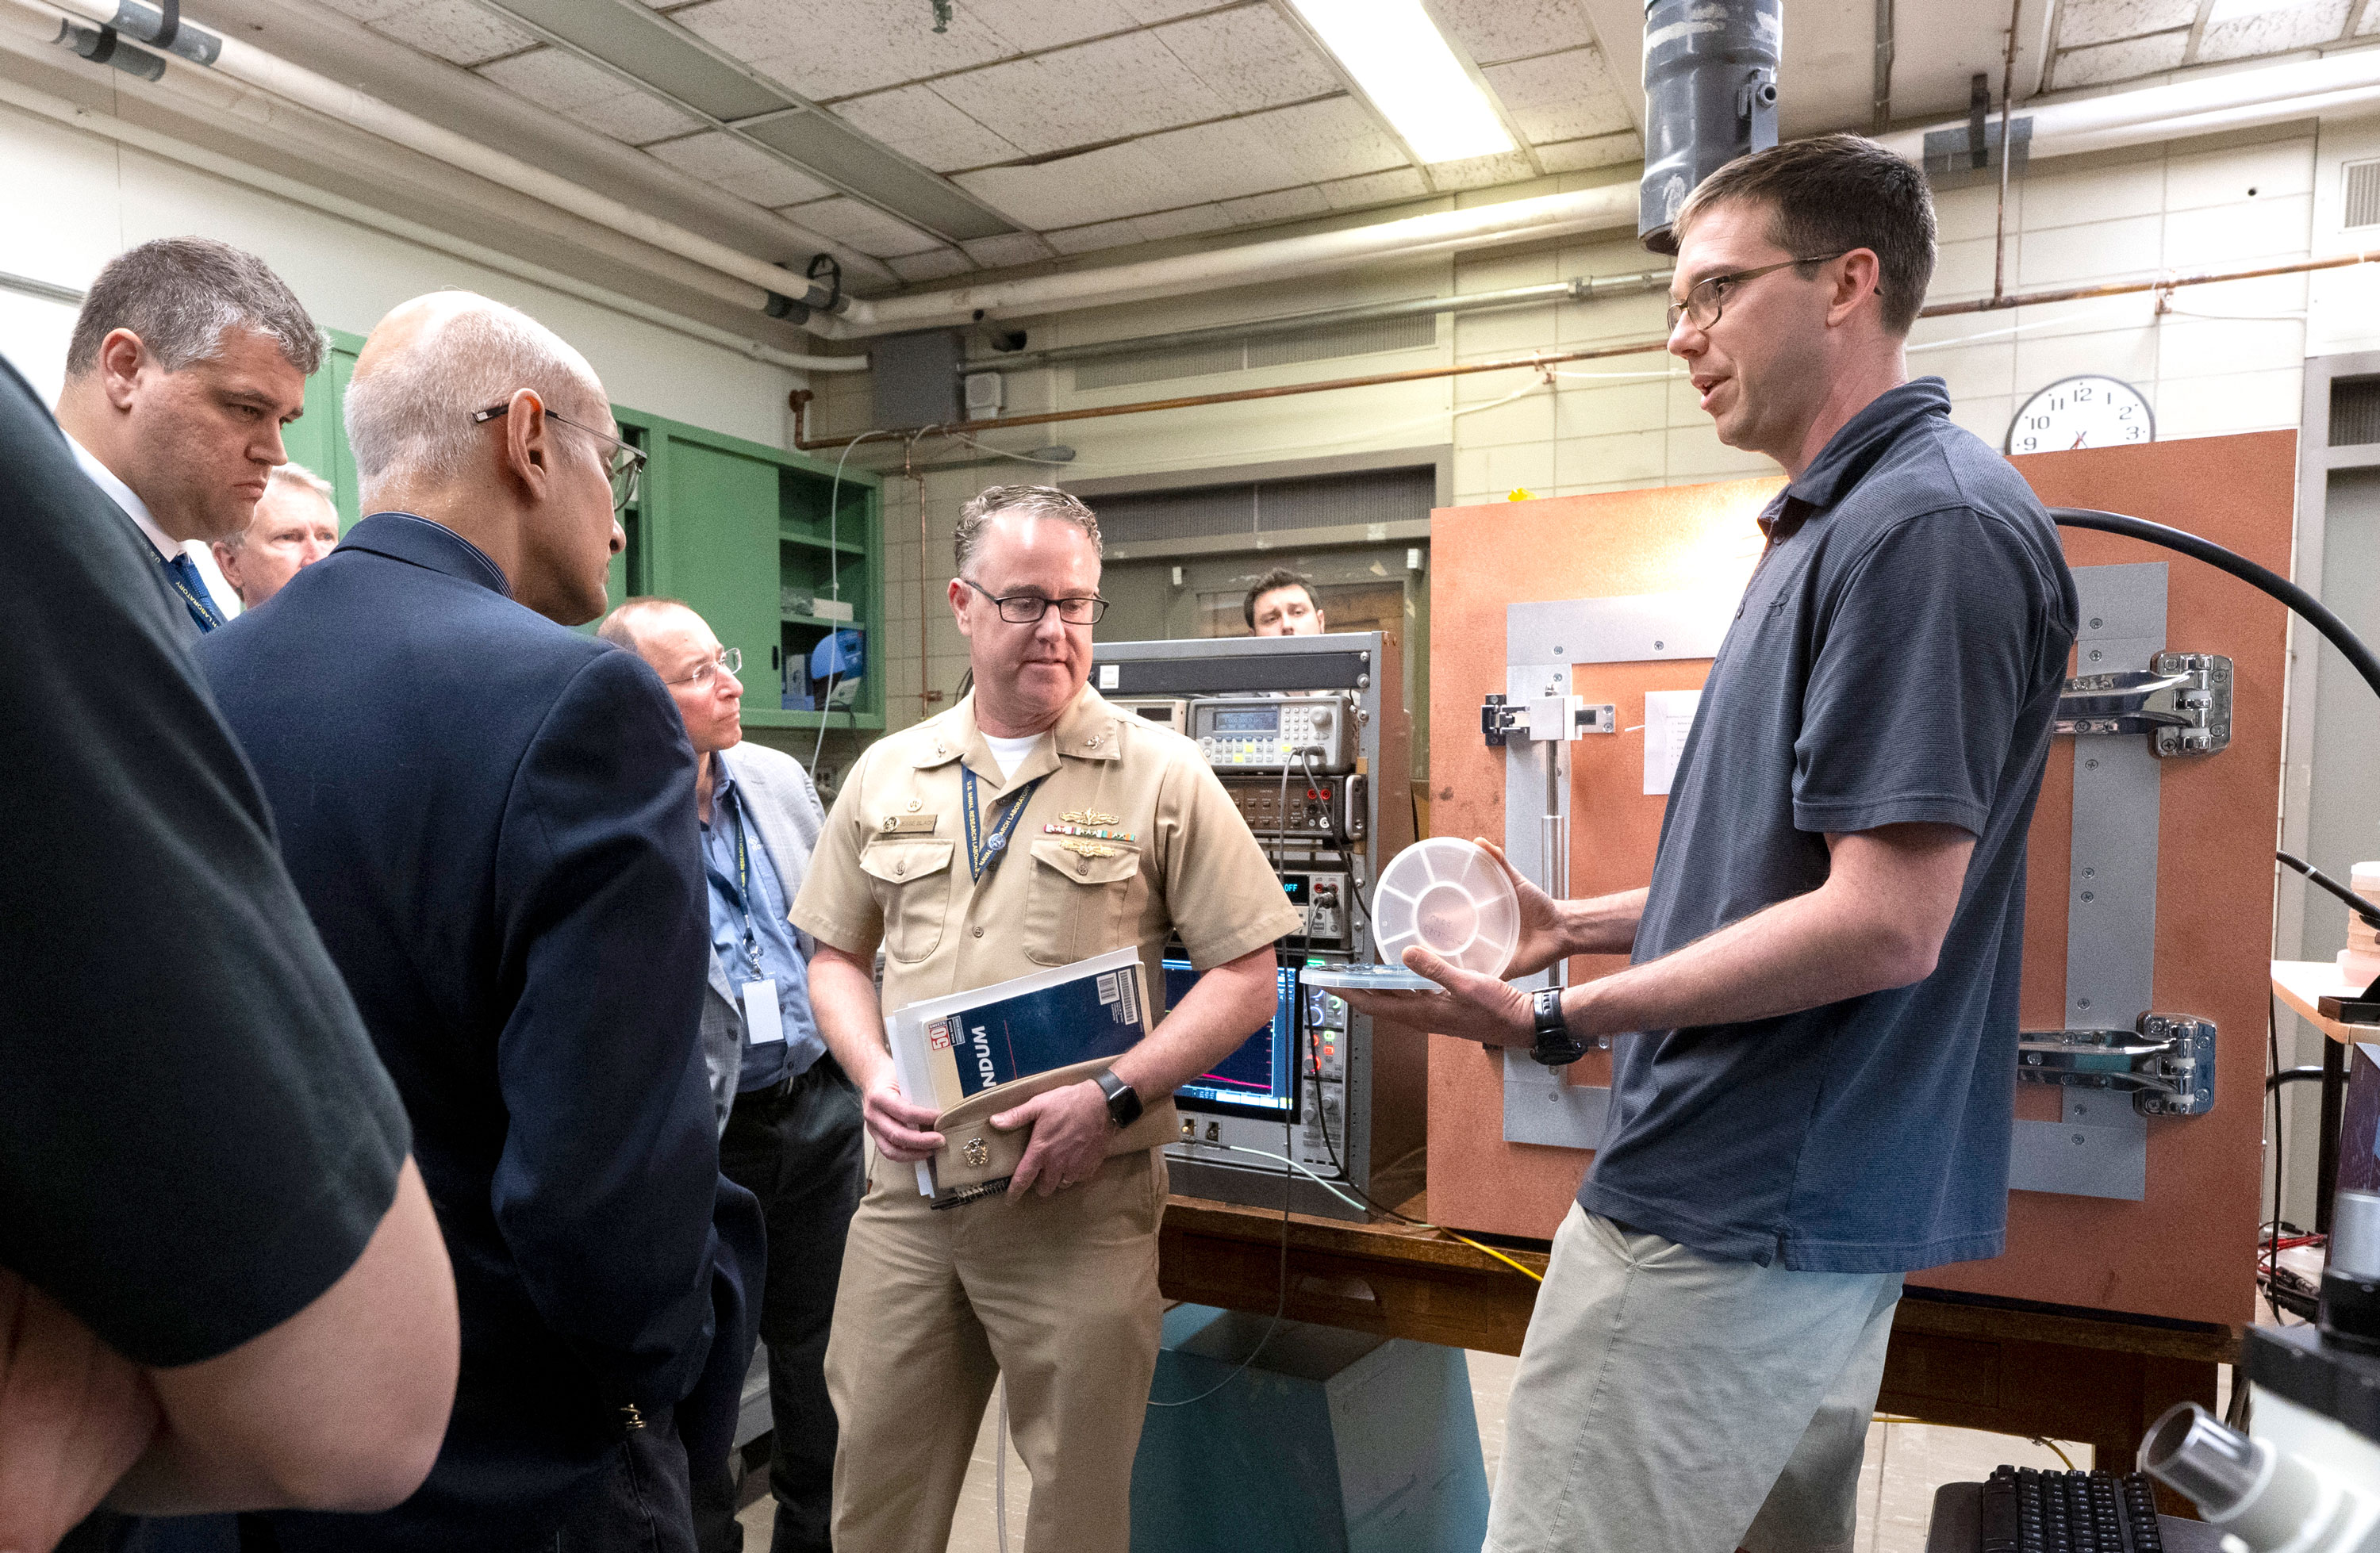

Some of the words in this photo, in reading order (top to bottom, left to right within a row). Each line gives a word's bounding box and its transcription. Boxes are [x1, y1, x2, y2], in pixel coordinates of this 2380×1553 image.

[2074, 388, 2092, 402] 12
[2107, 392, 2111, 405] 1
[2052, 398, 2064, 411] 11
[2120, 406, 2132, 420] 2
[2031, 416, 2050, 430] 10
[2126, 426, 2140, 440] 3
[2024, 437, 2037, 451] 9
[175, 581, 213, 622] LABORATORY
[969, 810, 977, 843] RESEARCH
[979, 849, 993, 866] NAVAL
[1008, 784, 1031, 822] LABORATORY
[931, 1027, 950, 1050] 50
